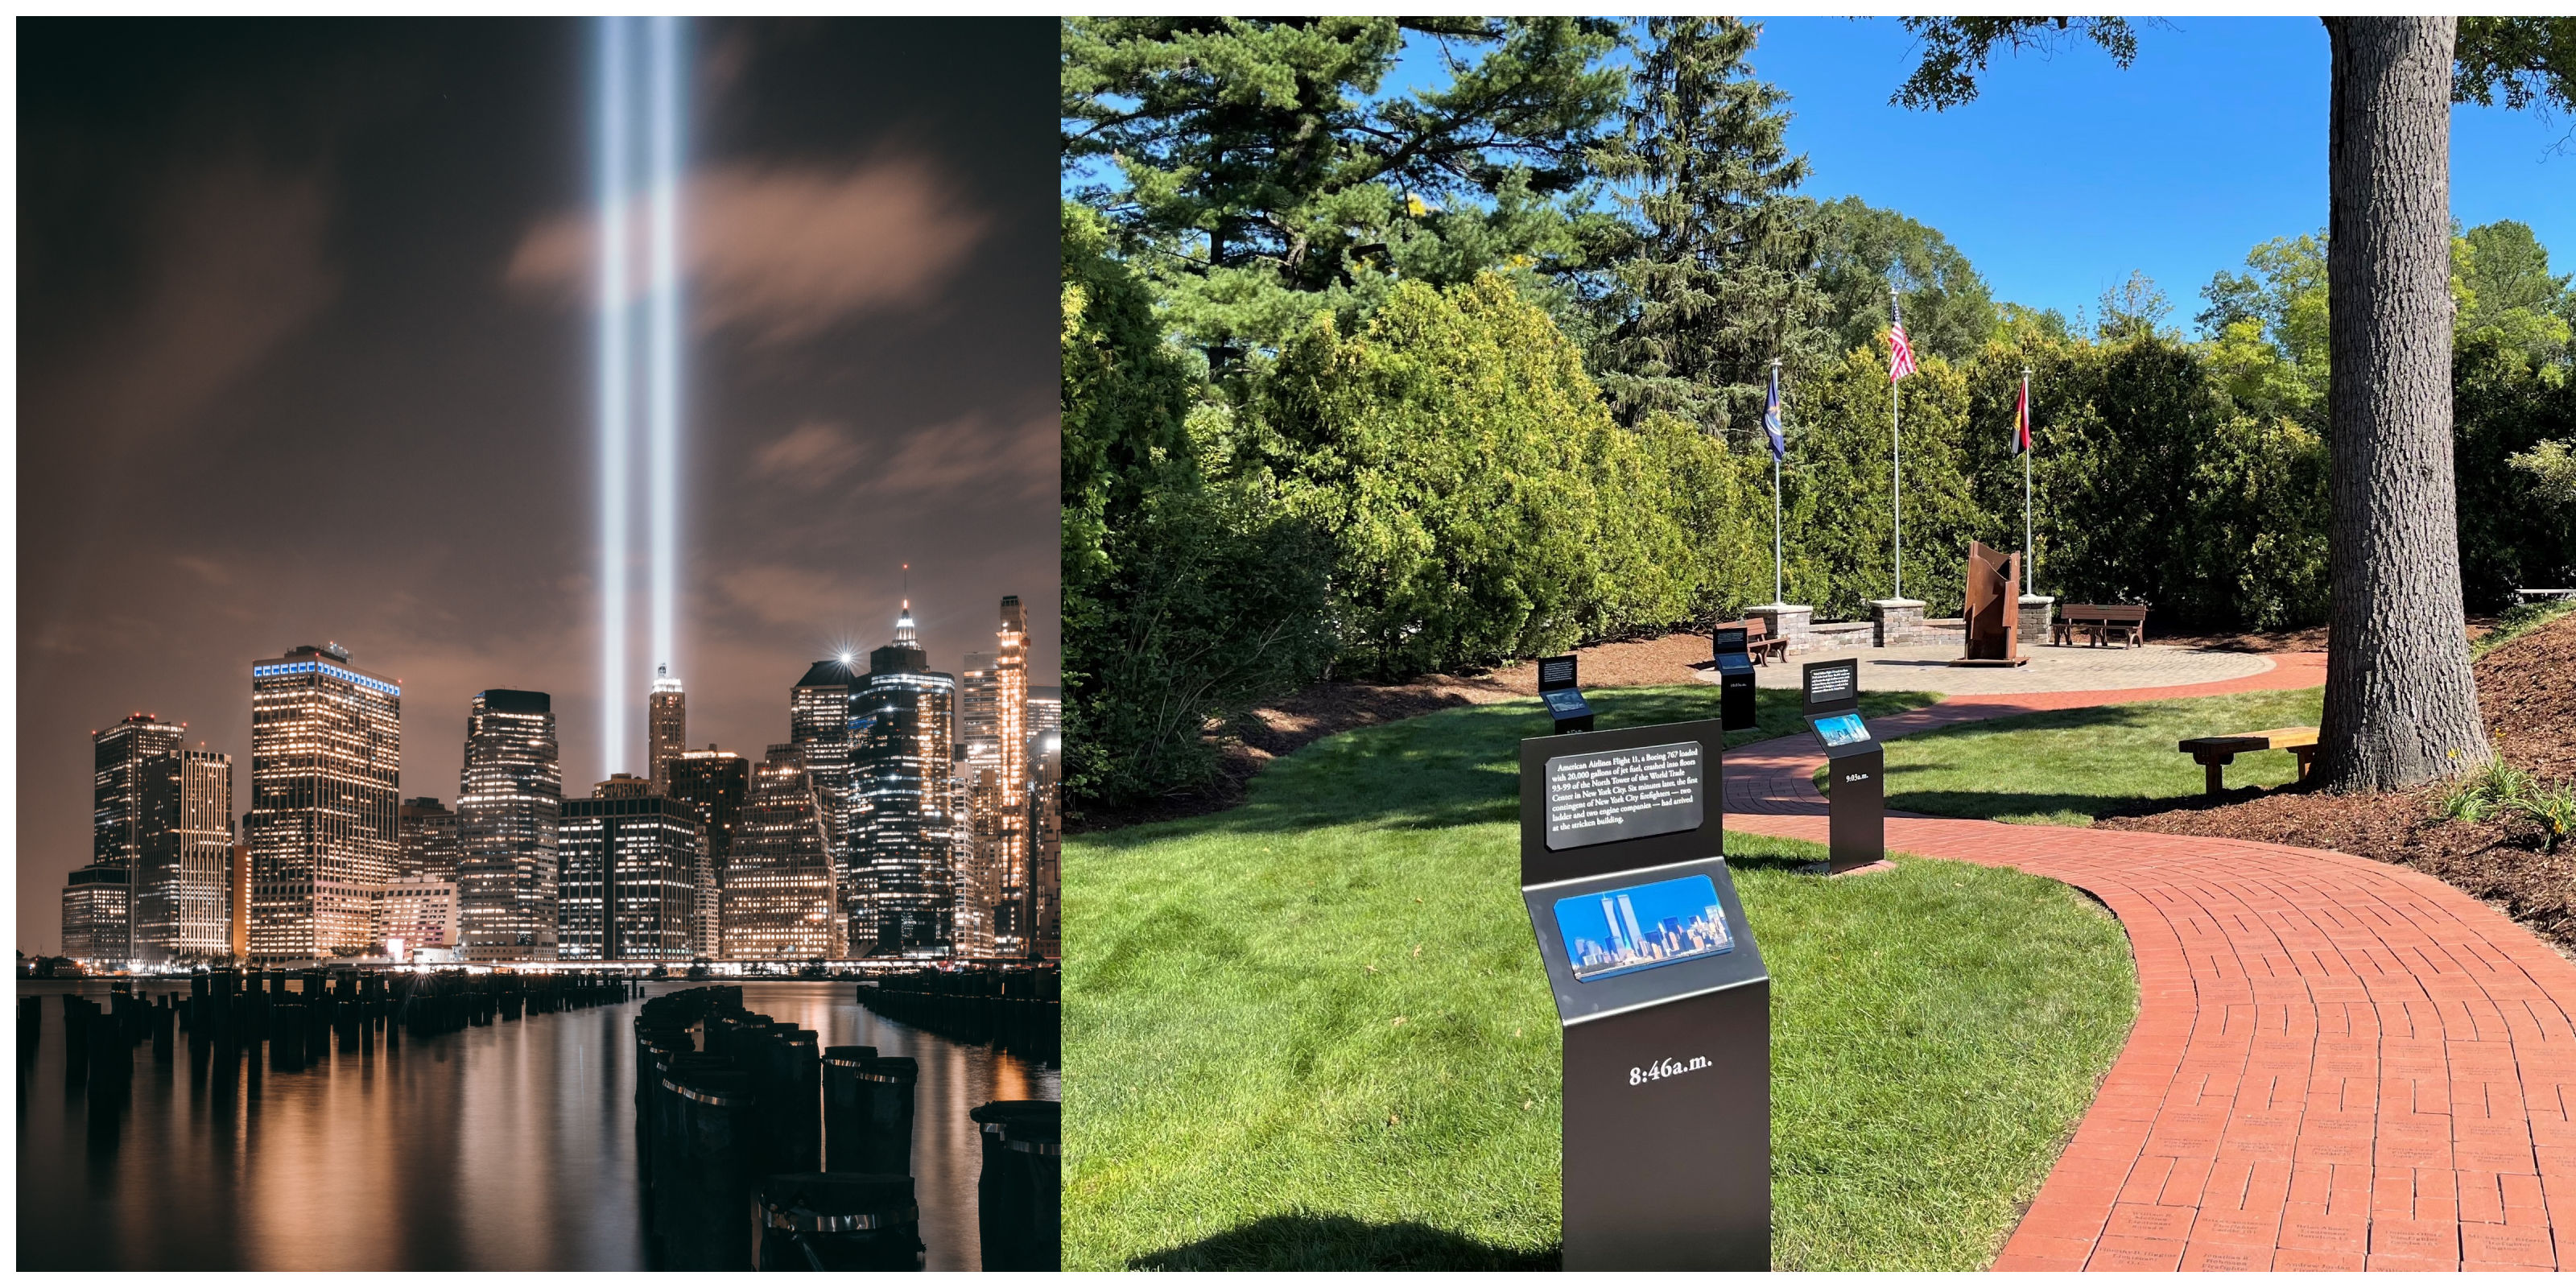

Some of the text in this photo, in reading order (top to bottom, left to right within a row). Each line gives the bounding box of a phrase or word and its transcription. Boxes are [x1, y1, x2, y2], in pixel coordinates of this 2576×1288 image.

[1558, 763, 1587, 772] American
[1613, 758, 1630, 766] Flight
[1646, 753, 1666, 762] Boeing
[1679, 749, 1698, 757] loaded
[1552, 784, 1570, 792] 93-99
[1669, 769, 1684, 777] Trade
[1568, 772, 1589, 781] 20,000
[1591, 770, 1612, 779] gallons
[1846, 774, 1868, 782] 9:03a.m.
[1552, 794, 1573, 802] Center
[1598, 788, 1611, 796] York
[1552, 803, 1586, 812] contingent
[1625, 795, 1638, 803] City
[1640, 791, 1670, 801] firefighters
[1553, 814, 1572, 822] ladder
[1600, 807, 1619, 816] engine
[1620, 803, 1651, 812] companies
[1674, 796, 1693, 805] arrived
[1572, 820, 1596, 829] stricken
[1629, 1055, 1712, 1086] 8:46a.m.
